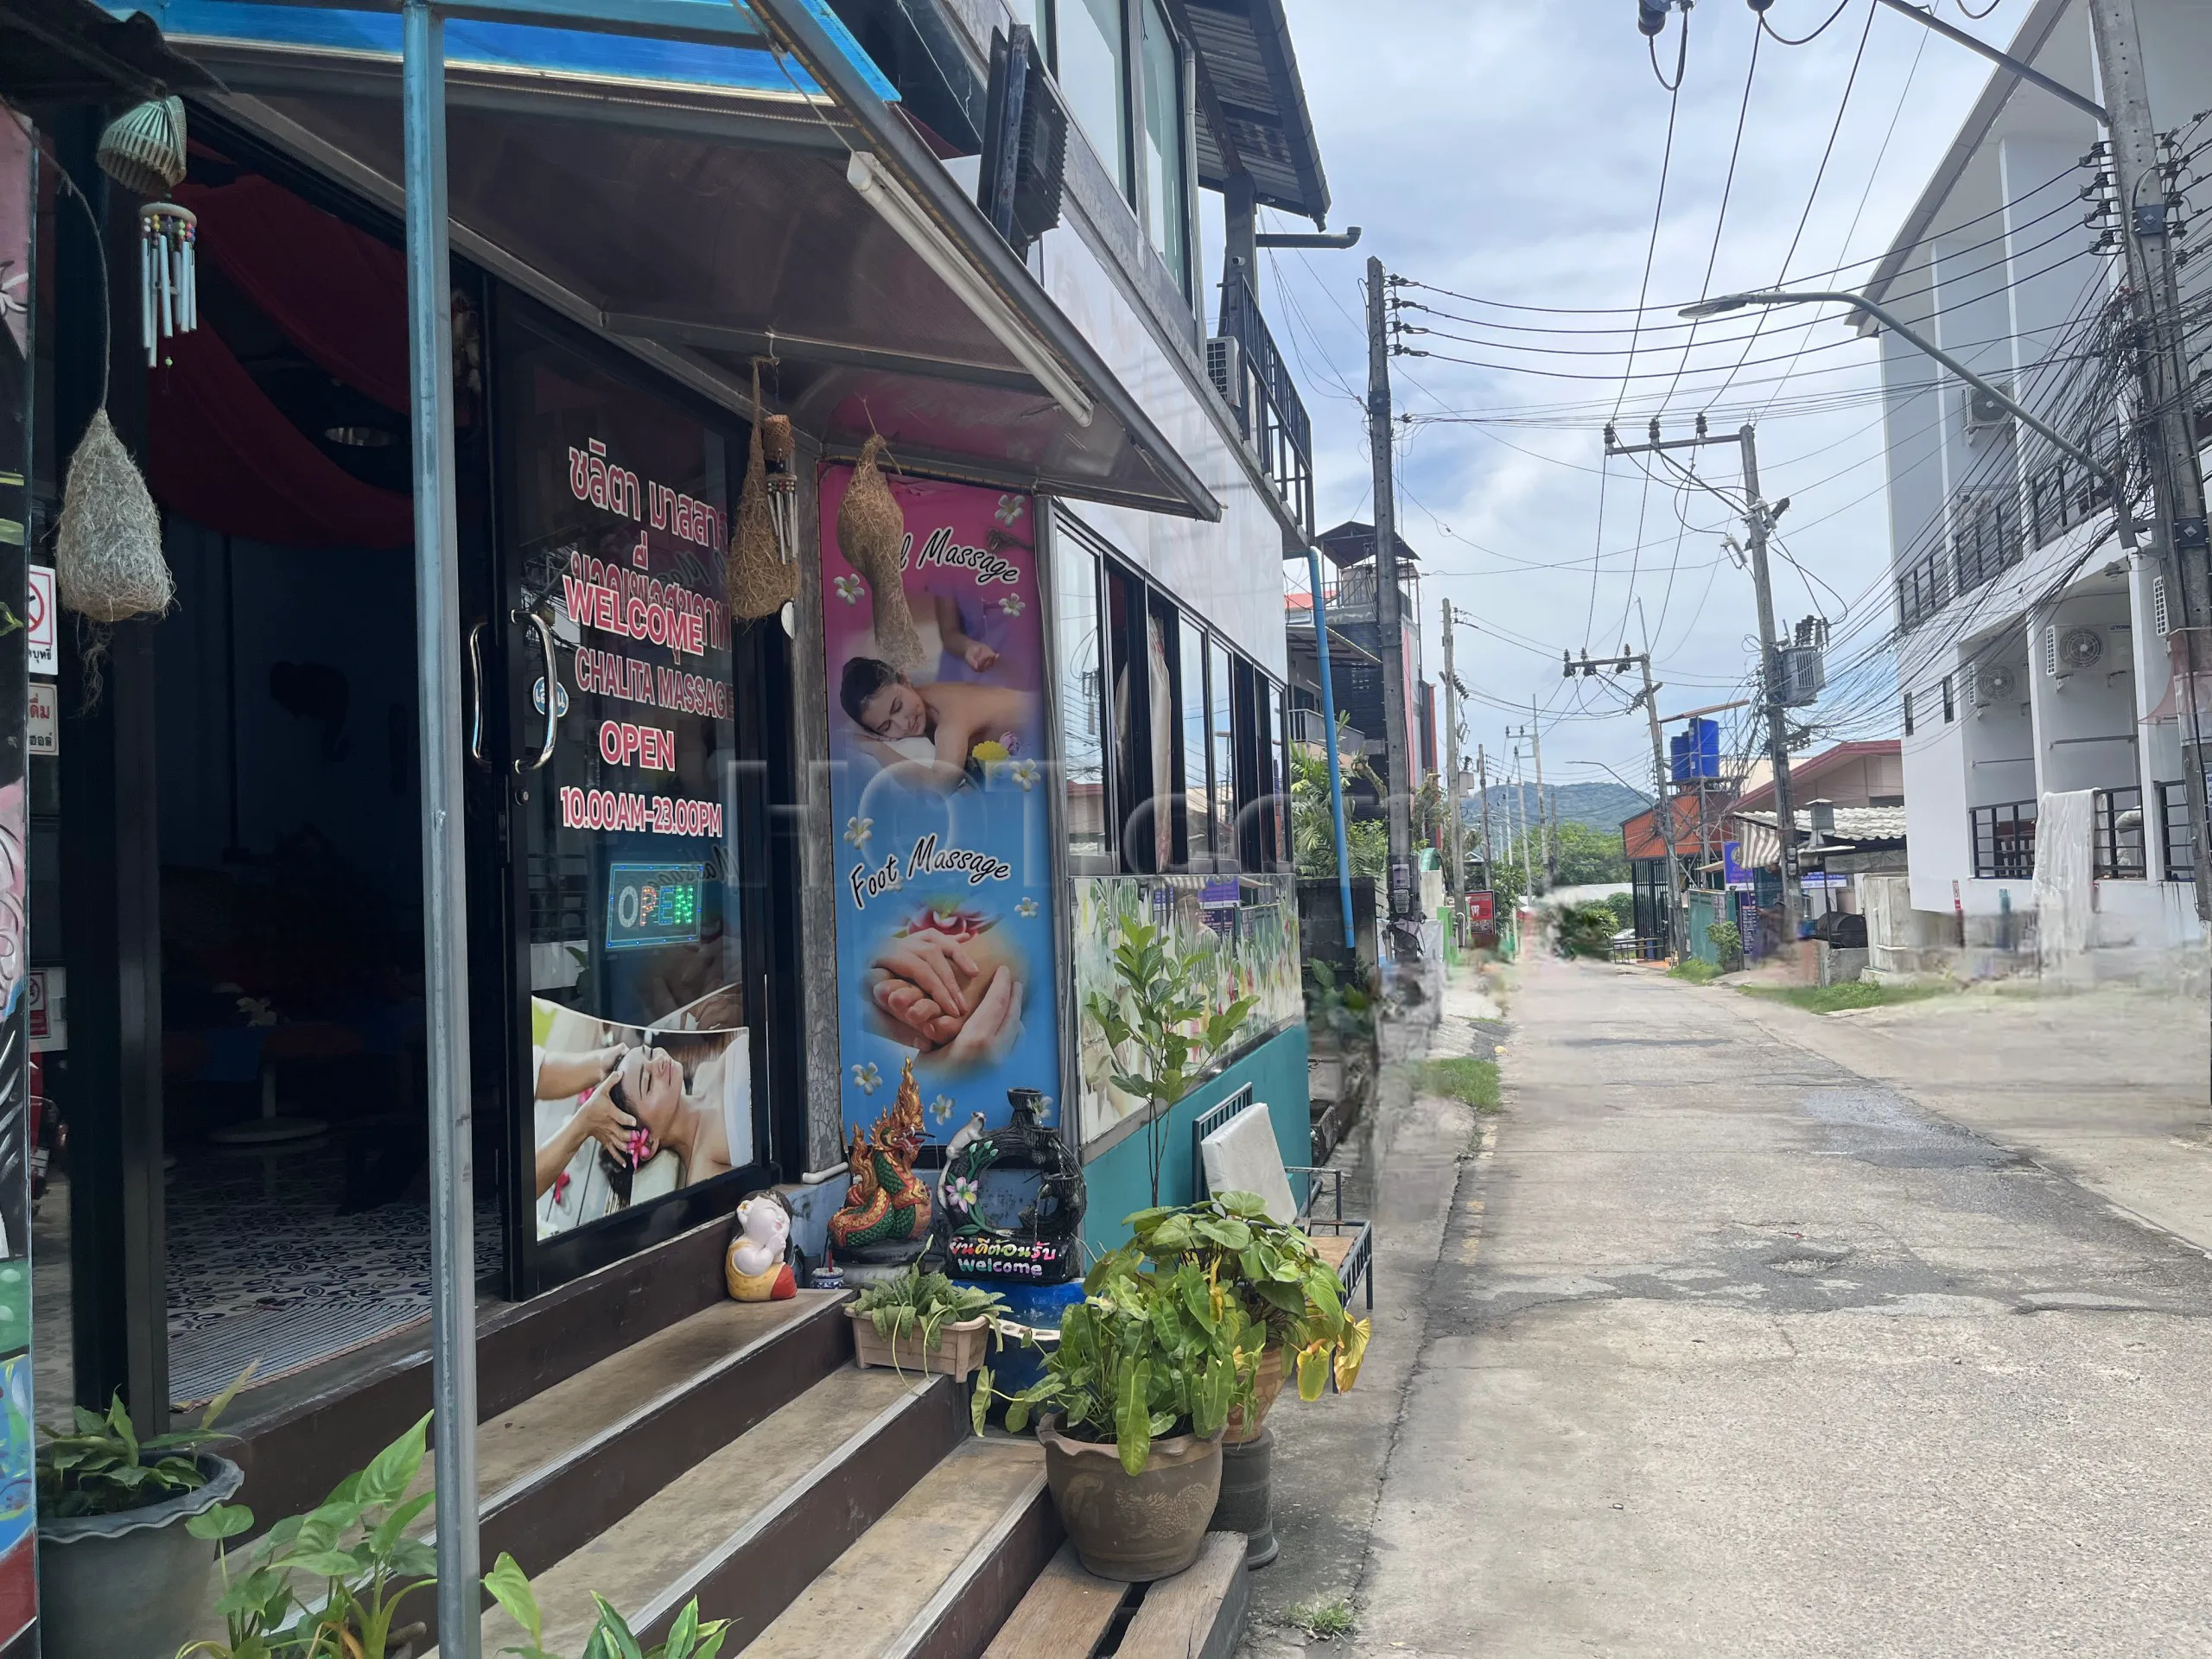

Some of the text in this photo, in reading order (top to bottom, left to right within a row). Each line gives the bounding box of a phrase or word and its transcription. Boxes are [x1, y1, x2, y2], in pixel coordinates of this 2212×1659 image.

[569, 437, 641, 521] ชลิตา
[916, 526, 1020, 585] Massage
[563, 575, 703, 656] WELCOME
[575, 646, 734, 721] CHALITA MASSAGE
[600, 721, 675, 772] OPEN
[560, 786, 723, 837] 10.00AM-23.00PM
[849, 833, 1010, 910] Foot Massage
[618, 886, 694, 928] OPEN
